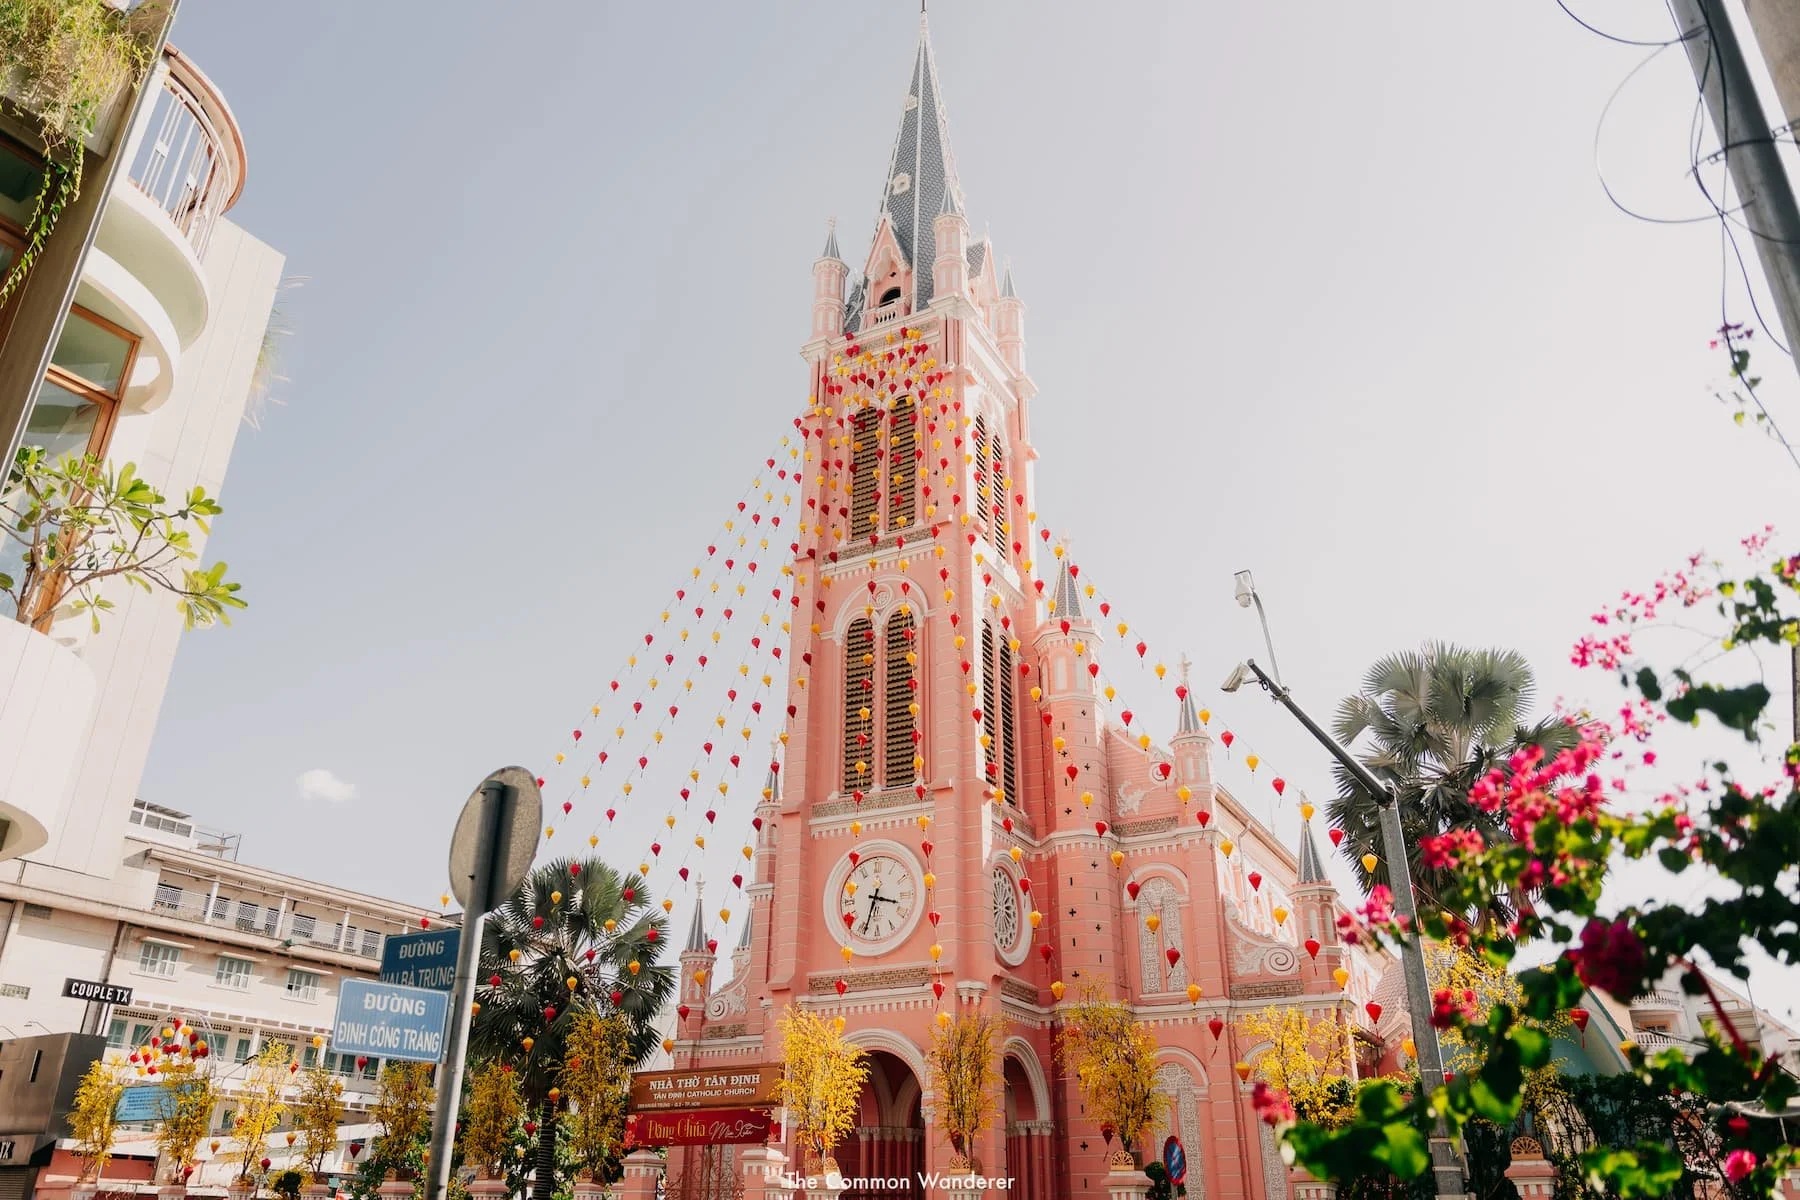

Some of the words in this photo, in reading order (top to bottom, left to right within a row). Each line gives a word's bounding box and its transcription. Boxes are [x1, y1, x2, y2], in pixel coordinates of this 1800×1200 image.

[399, 939, 445, 959] ĐƯỜNG
[71, 982, 114, 1000] COUPLE
[115, 989, 130, 1003] TX
[364, 992, 426, 1016] ĐƯỜNG
[337, 1021, 368, 1045] ĐINH
[369, 1021, 401, 1049] CÔNG
[403, 1025, 440, 1053] TRÁNG
[649, 1077, 674, 1090] NHÀ
[677, 1075, 701, 1088] THỜ
[704, 1075, 728, 1087] TÂN
[687, 1089, 722, 1098] CATHOLIC
[724, 1088, 756, 1096] CHURCH
